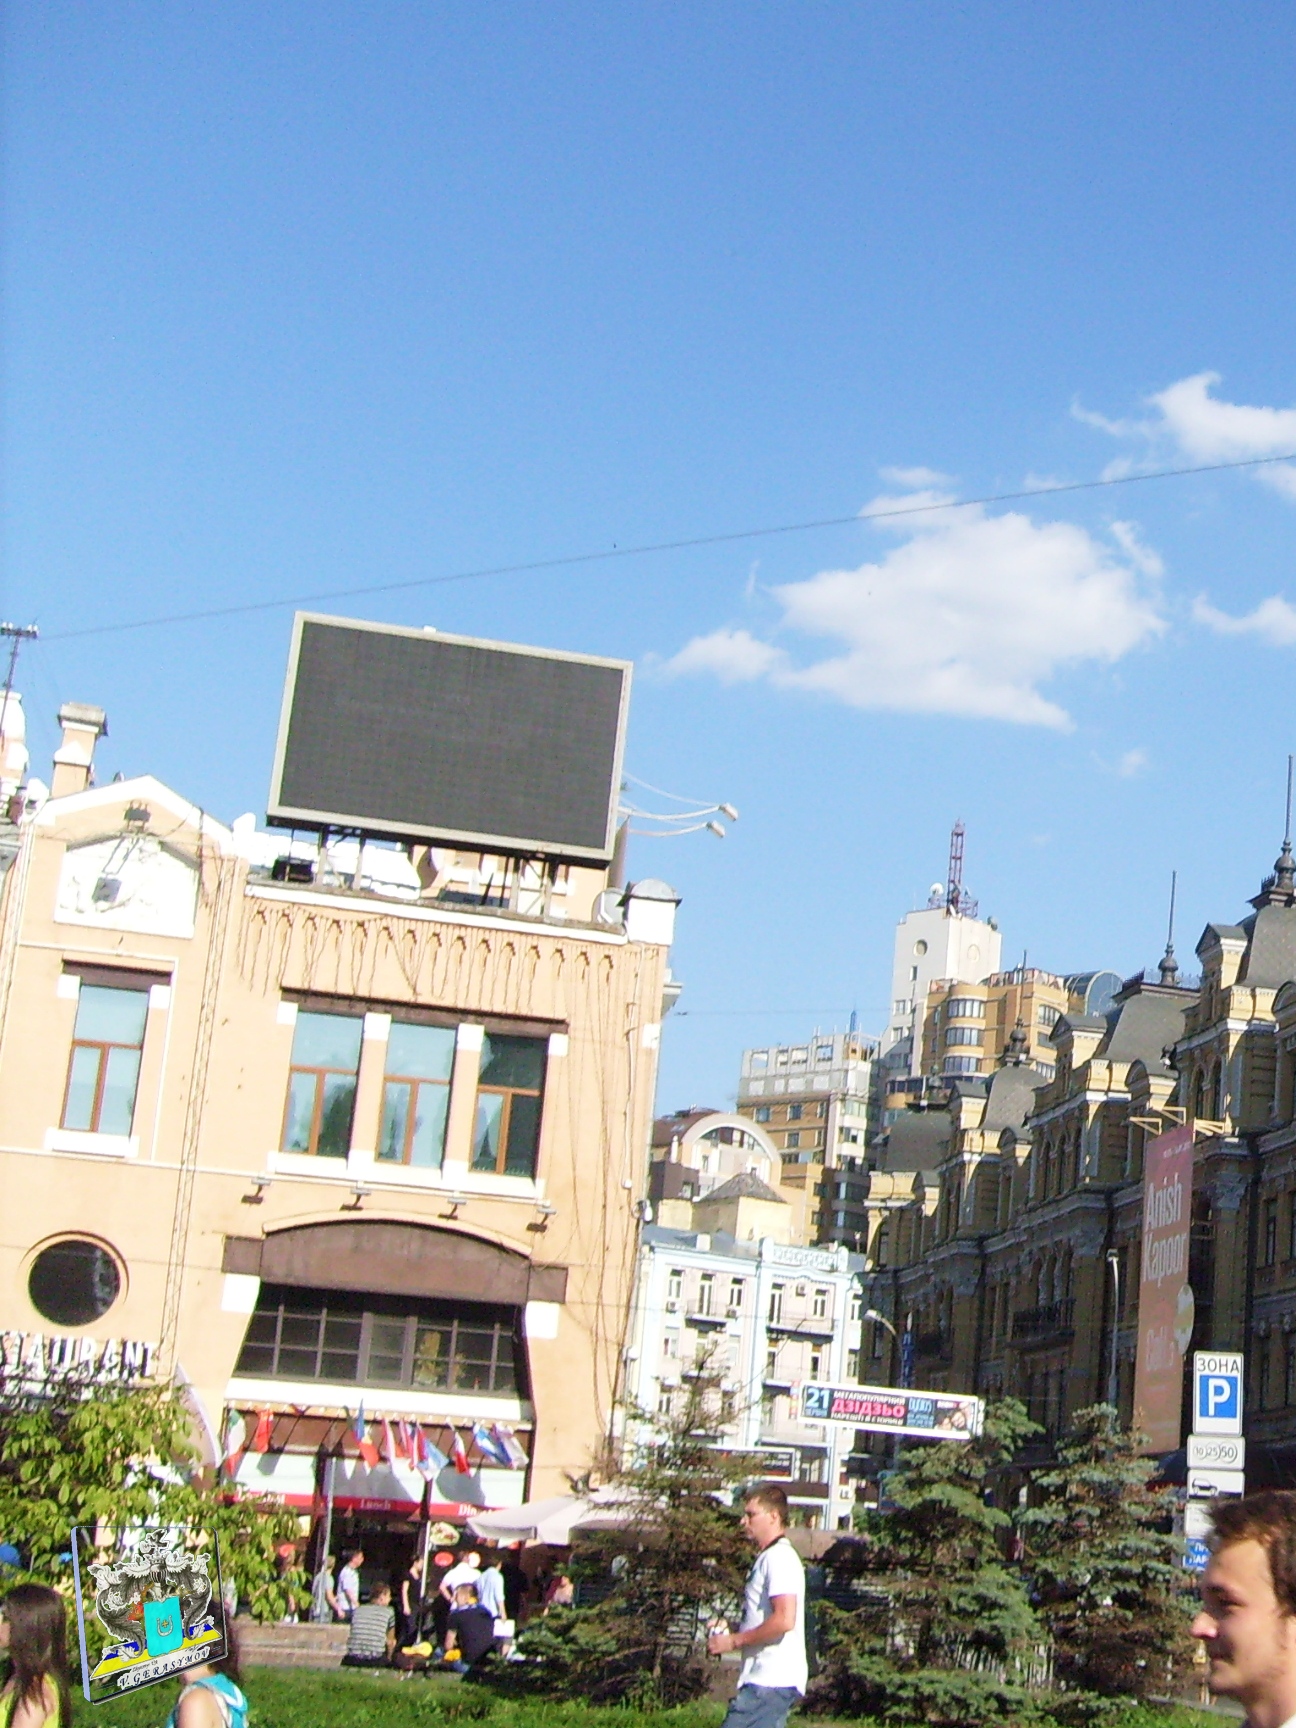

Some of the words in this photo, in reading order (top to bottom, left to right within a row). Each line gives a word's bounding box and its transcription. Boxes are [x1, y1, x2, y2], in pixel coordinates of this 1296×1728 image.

[1145, 1172, 1182, 1232] Anish
[1143, 1233, 1187, 1288] Kapoor
[1197, 1357, 1240, 1374] ЗОНА
[807, 1388, 830, 1409] 21
[1208, 1378, 1231, 1416] P
[831, 1399, 905, 1418] ДЗІДЗЬО
[1220, 1446, 1235, 1458] 50
[359, 1499, 391, 1511] Lunch
